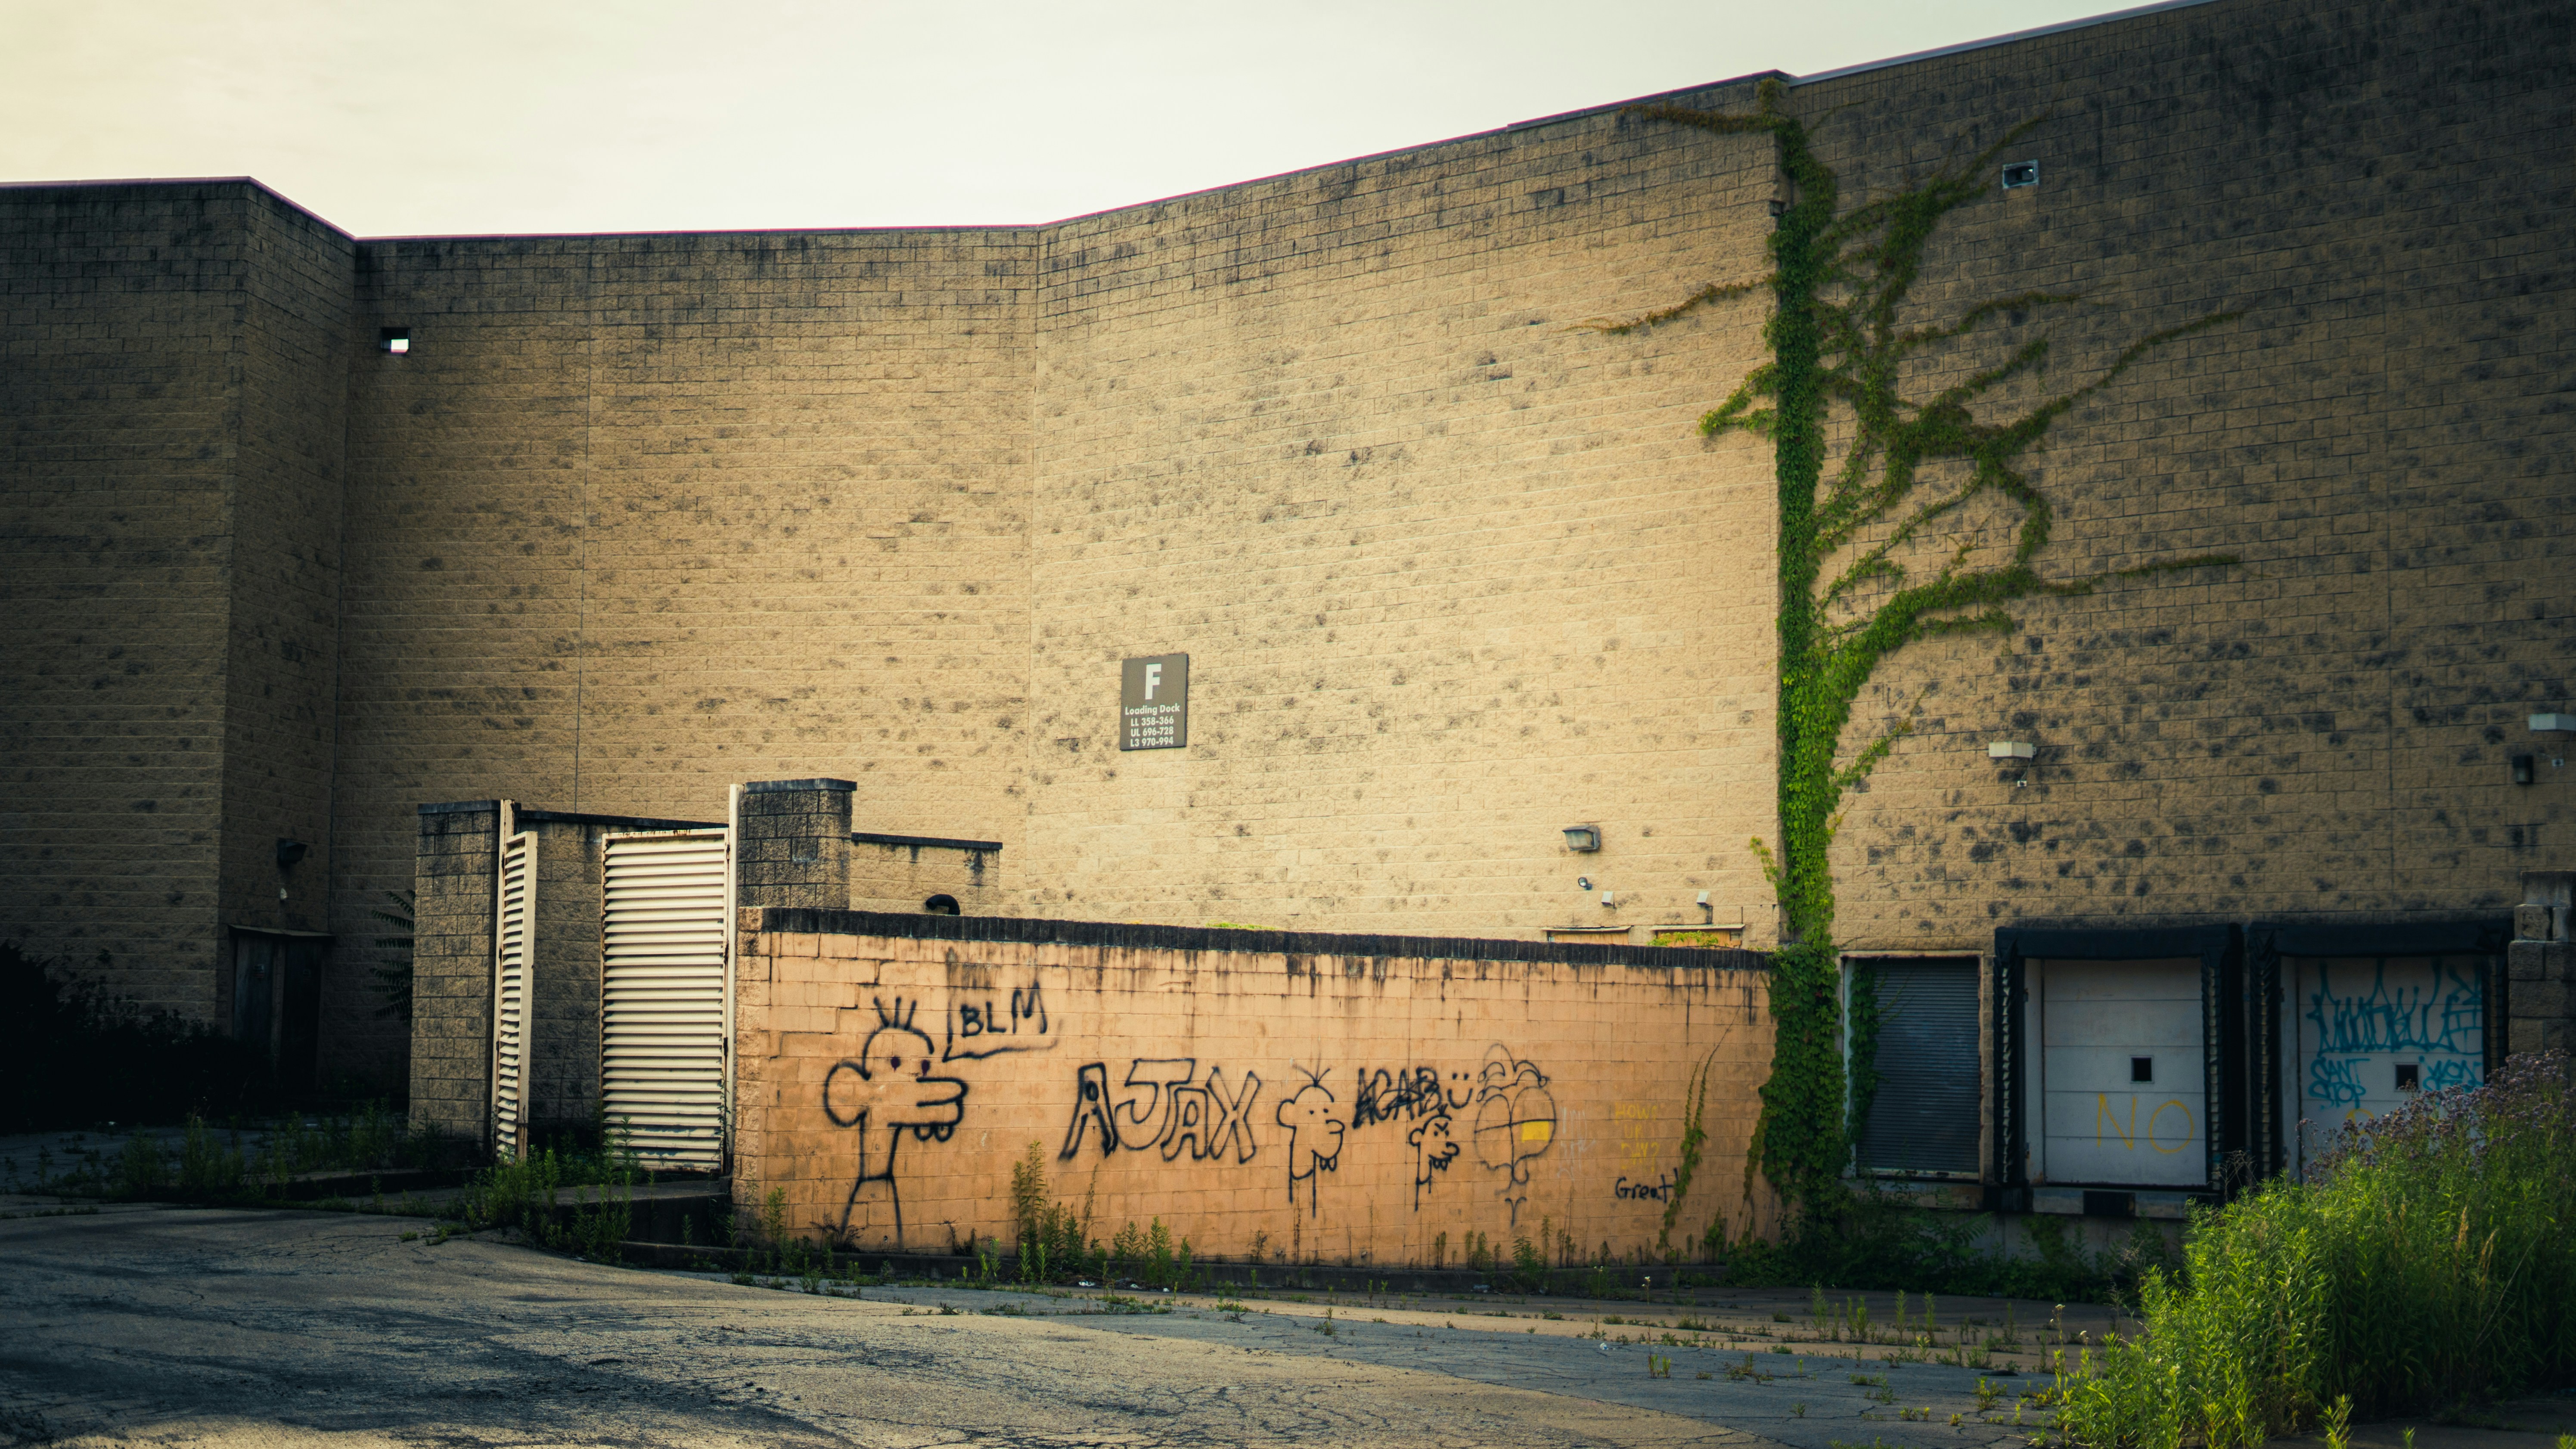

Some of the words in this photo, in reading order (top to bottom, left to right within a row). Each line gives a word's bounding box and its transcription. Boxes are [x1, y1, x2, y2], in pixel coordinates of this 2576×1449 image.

[1145, 664, 1162, 700] F
[1125, 705, 1158, 716] Loading
[1160, 703, 1180, 713] Dock
[1131, 718, 1139, 726] LL
[1141, 716, 1174, 726] 358-366
[1130, 738, 1140, 747] L3
[1142, 736, 1174, 746] 970-994
[1131, 728, 1140, 737] UL
[1142, 726, 1174, 736] 696-728
[960, 980, 1049, 1038] BLM
[1058, 1057, 1262, 1164] AJAX
[2096, 1092, 2194, 1154] NO
